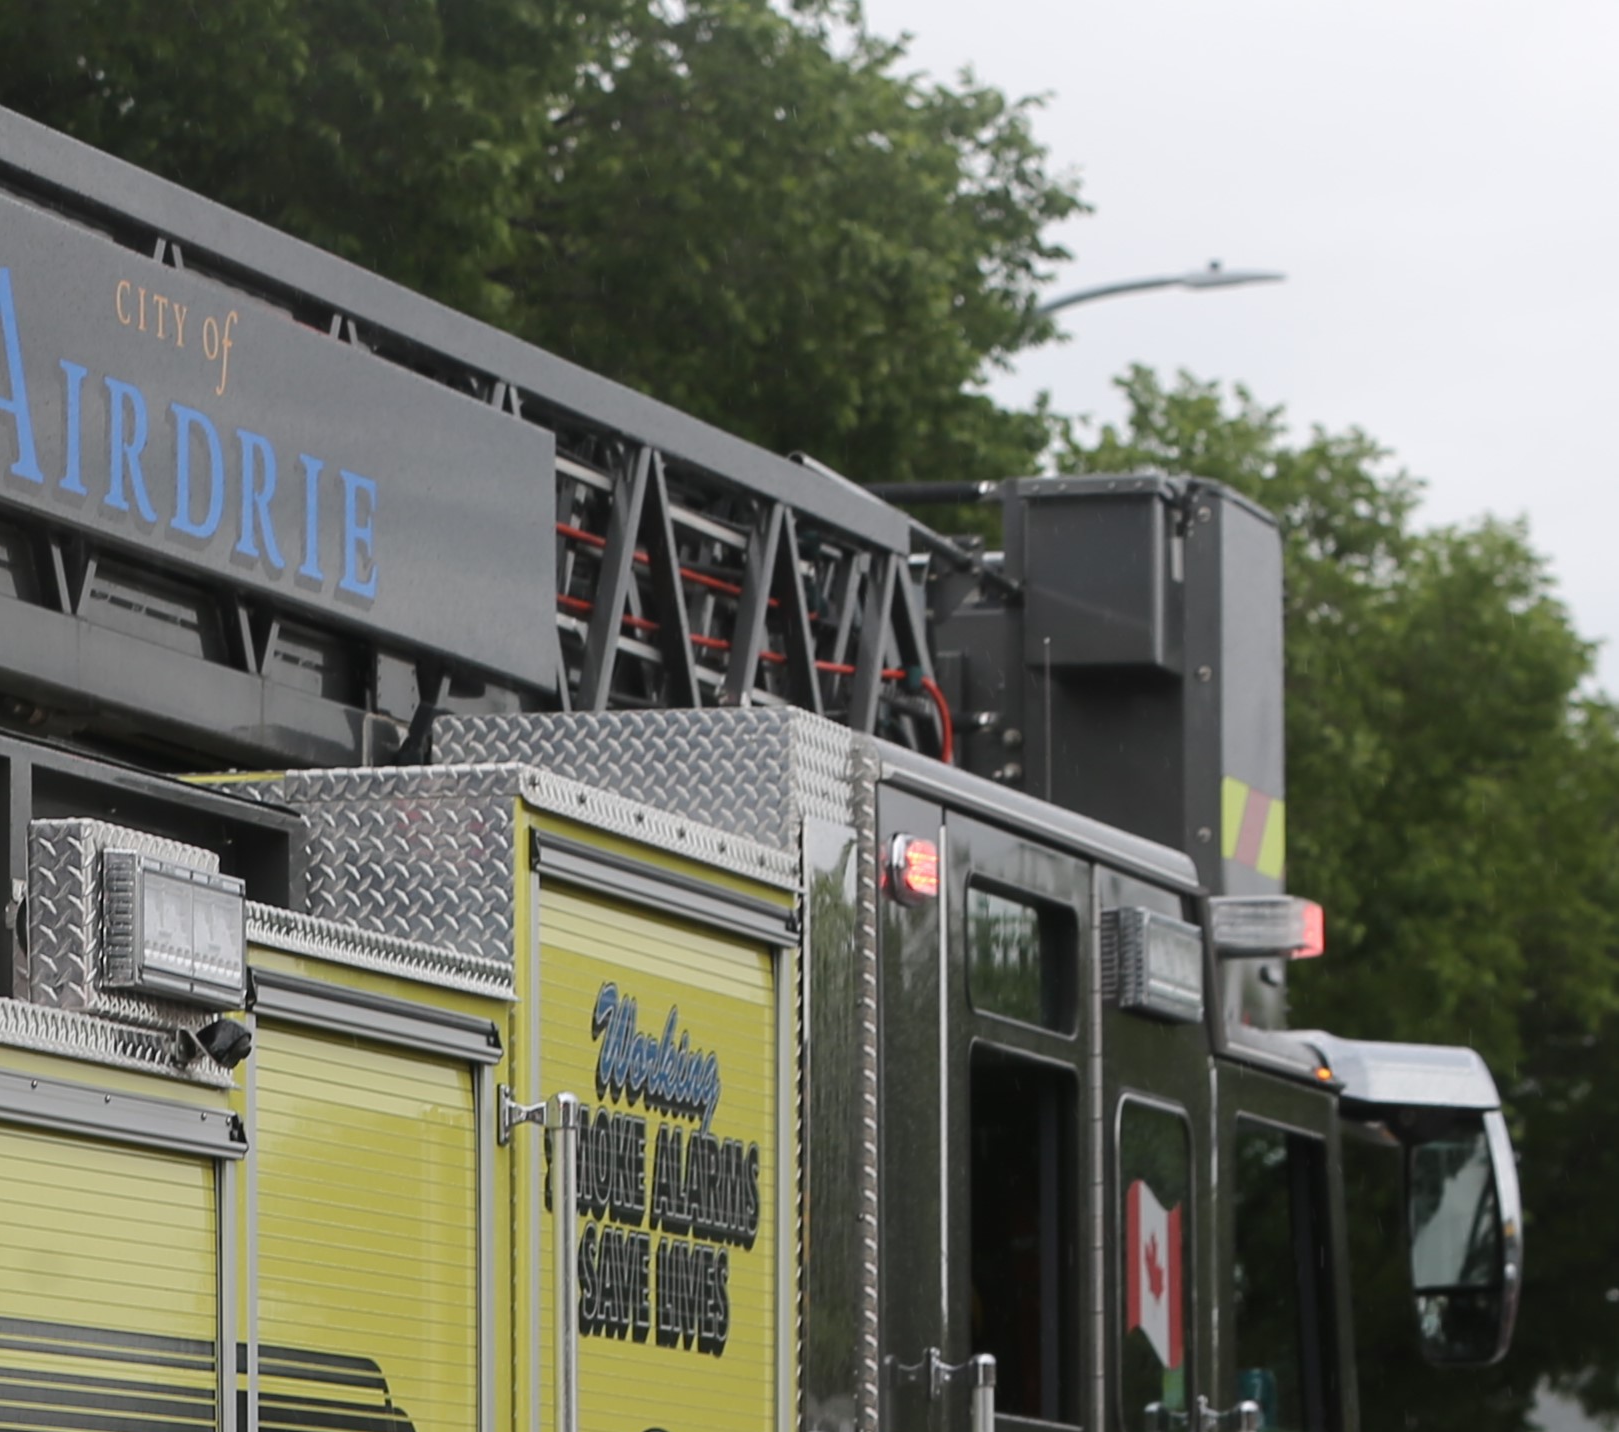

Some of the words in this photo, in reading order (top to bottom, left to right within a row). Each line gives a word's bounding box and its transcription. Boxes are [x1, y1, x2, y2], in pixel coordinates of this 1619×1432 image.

[116, 280, 185, 349] CITY
[203, 311, 238, 395] of
[592, 981, 722, 1135] Working
[545, 1104, 647, 1228] MOKE
[650, 1122, 760, 1251] ALARMS
[578, 1220, 650, 1344] SAVE
[655, 1235, 729, 1358] LIVES
